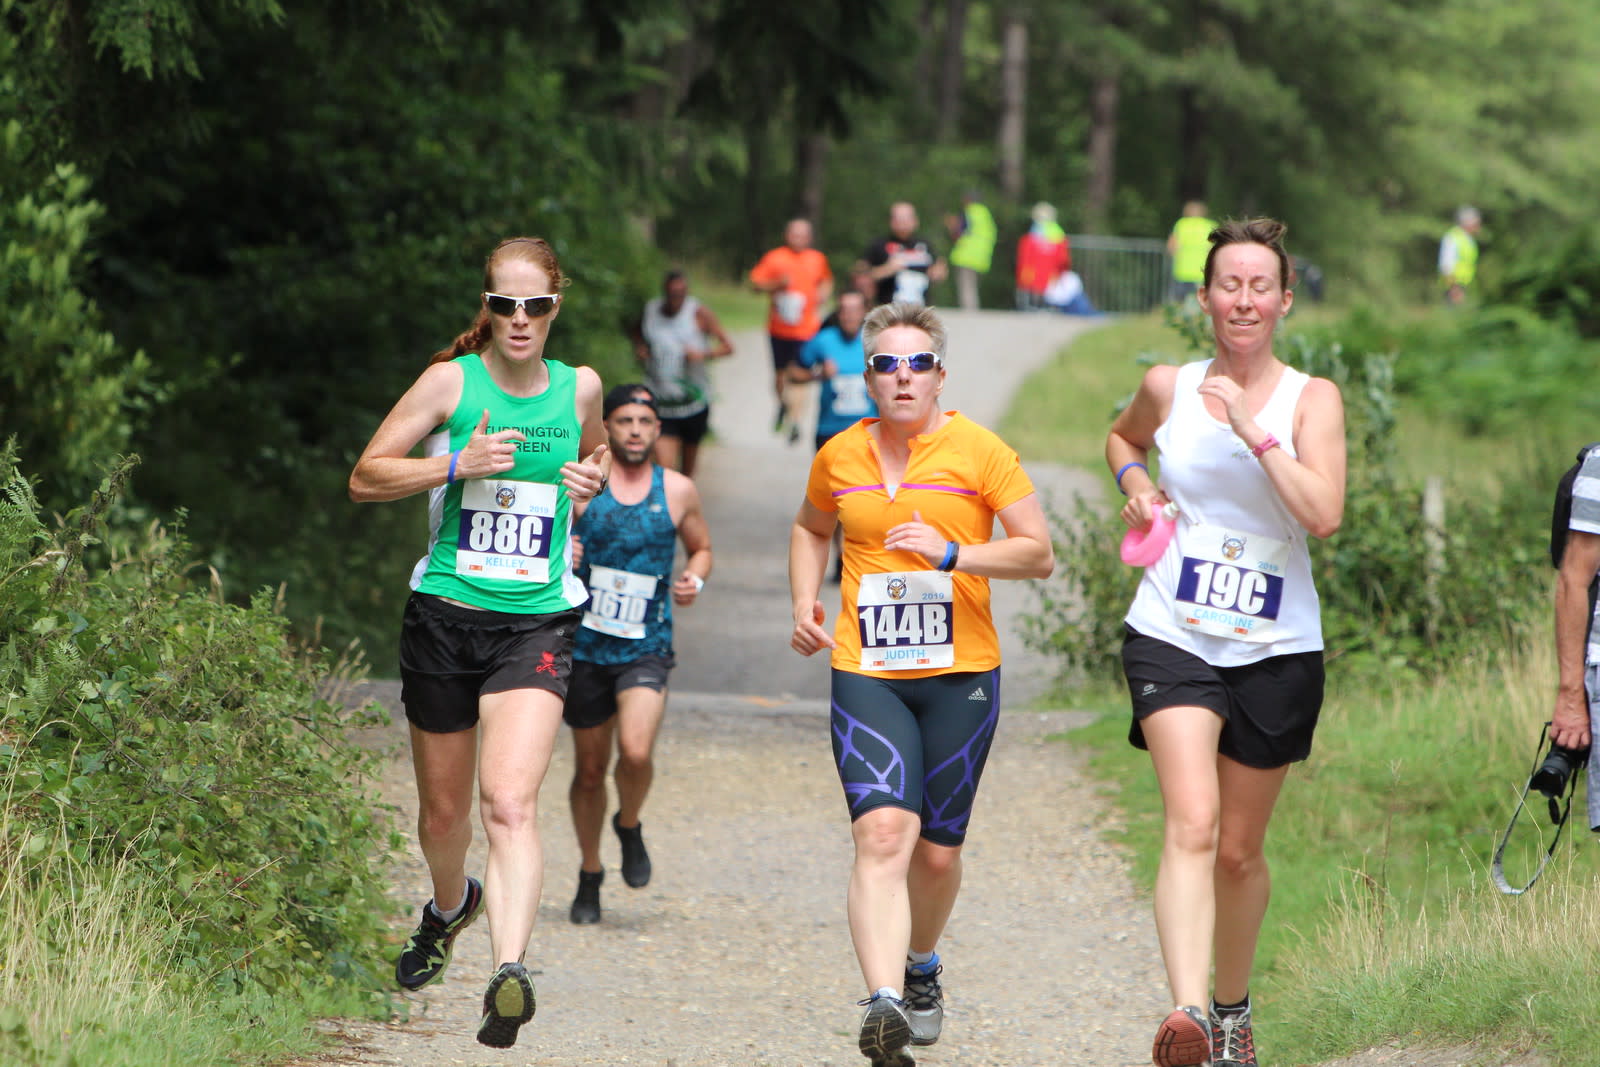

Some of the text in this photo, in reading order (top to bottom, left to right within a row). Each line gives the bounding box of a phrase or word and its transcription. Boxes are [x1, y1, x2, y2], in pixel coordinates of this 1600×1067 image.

[474, 426, 570, 439] TUINGTON
[503, 441, 551, 453] REEN
[529, 505, 549, 513] 2019
[469, 511, 543, 556] 88C
[485, 556, 525, 569] KELLEY
[1257, 560, 1279, 572] 2019
[1193, 562, 1268, 615] 19C
[922, 592, 945, 601] 2019
[1192, 608, 1255, 629] CAROLINE
[859, 604, 948, 647] 144B
[885, 649, 926, 660] JUDITH
